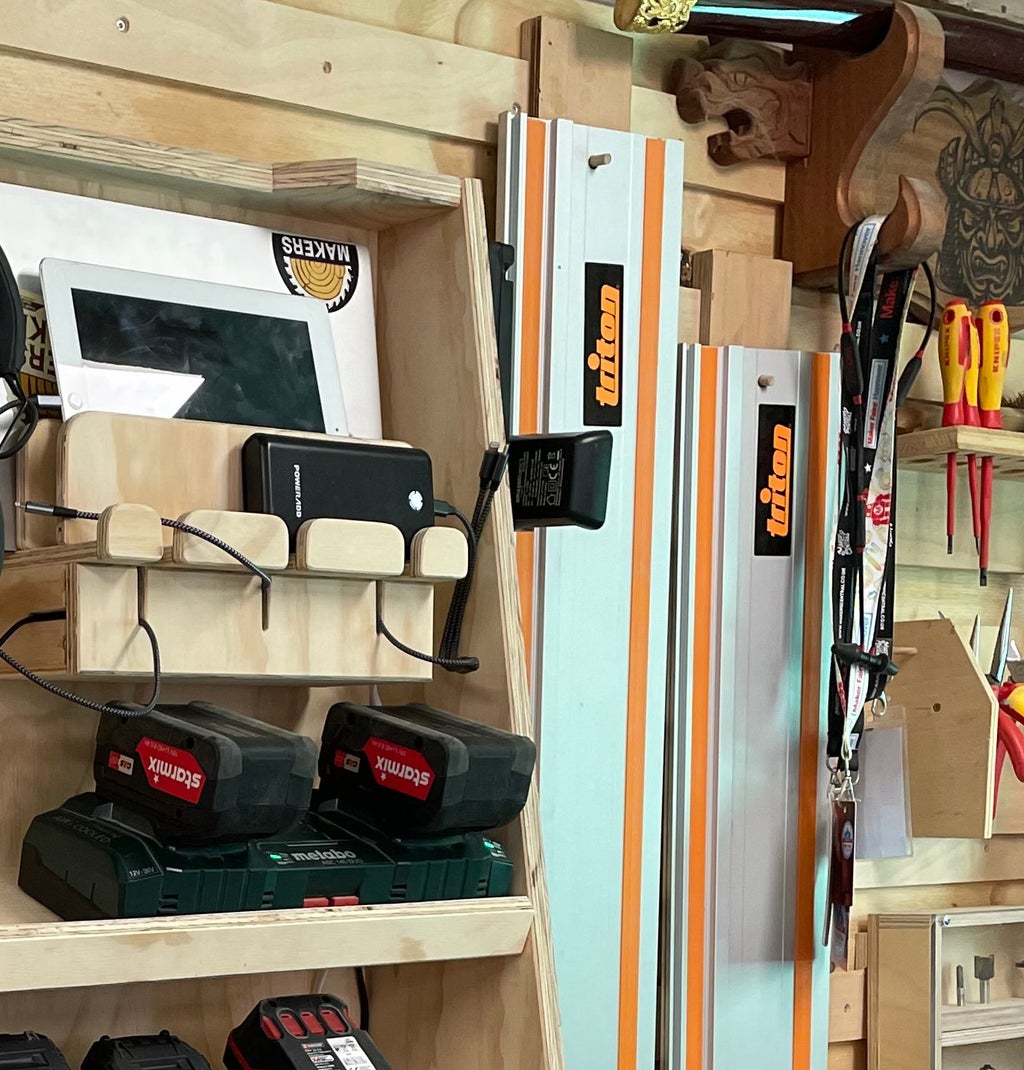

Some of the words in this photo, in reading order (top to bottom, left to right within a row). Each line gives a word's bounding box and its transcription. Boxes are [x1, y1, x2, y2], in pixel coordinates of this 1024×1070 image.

[280, 235, 352, 263] MAKERS
[587, 284, 621, 407] triton
[759, 423, 792, 537] triton
[147, 755, 202, 790] starmix
[374, 755, 432, 787] starmix
[290, 849, 358, 862] metabo
